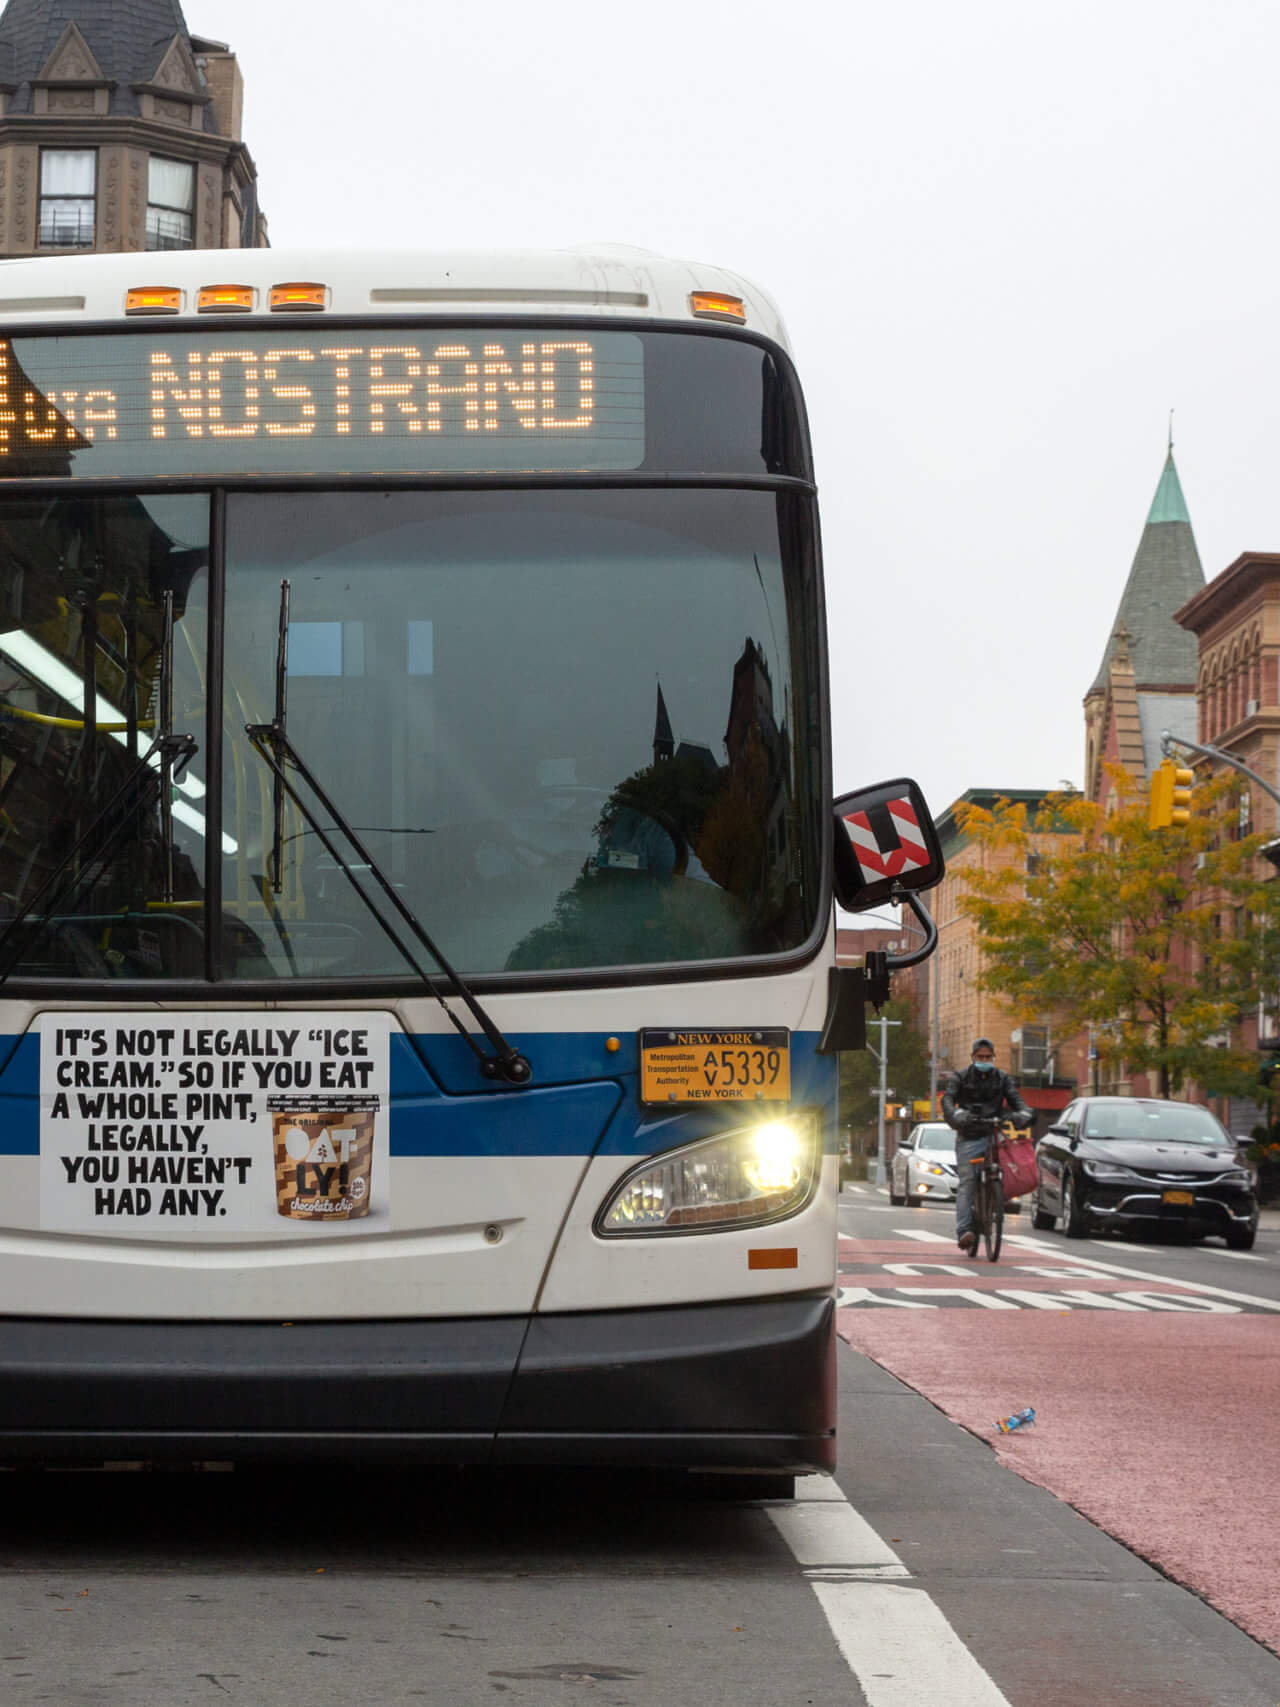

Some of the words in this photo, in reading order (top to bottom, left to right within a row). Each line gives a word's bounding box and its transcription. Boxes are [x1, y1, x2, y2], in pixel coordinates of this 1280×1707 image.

[150, 342, 594, 438] NOSTRAND
[55, 1029, 108, 1056] IT'S
[116, 1029, 175, 1056] NOT
[183, 1029, 300, 1057] LEGALLY
[678, 1033, 711, 1044] NEW
[715, 1033, 752, 1044] YORK
[648, 1065, 699, 1073] Transportation
[650, 1053, 695, 1062] Metropolitan
[179, 1061, 214, 1088] SO
[222, 1061, 246, 1088] IF
[253, 1061, 312, 1088] YOU
[320, 1061, 374, 1089] EAT
[656, 1077, 689, 1086] Authority
[687, 1090, 712, 1098] NEW
[715, 1090, 743, 1098] YORK
[50, 1093, 71, 1119] A
[77, 1093, 178, 1120] WHOLE
[186, 1093, 257, 1123] PINT,
[88, 1125, 208, 1155] LEGALLY,
[61, 1157, 120, 1183] YOU
[127, 1157, 252, 1184] HAVEN'T
[296, 1164, 349, 1196] LY!
[95, 1188, 152, 1216] HAD
[159, 1188, 227, 1216] ANY.
[290, 1197, 334, 1212] chocolate
[335, 1197, 353, 1212] chip
